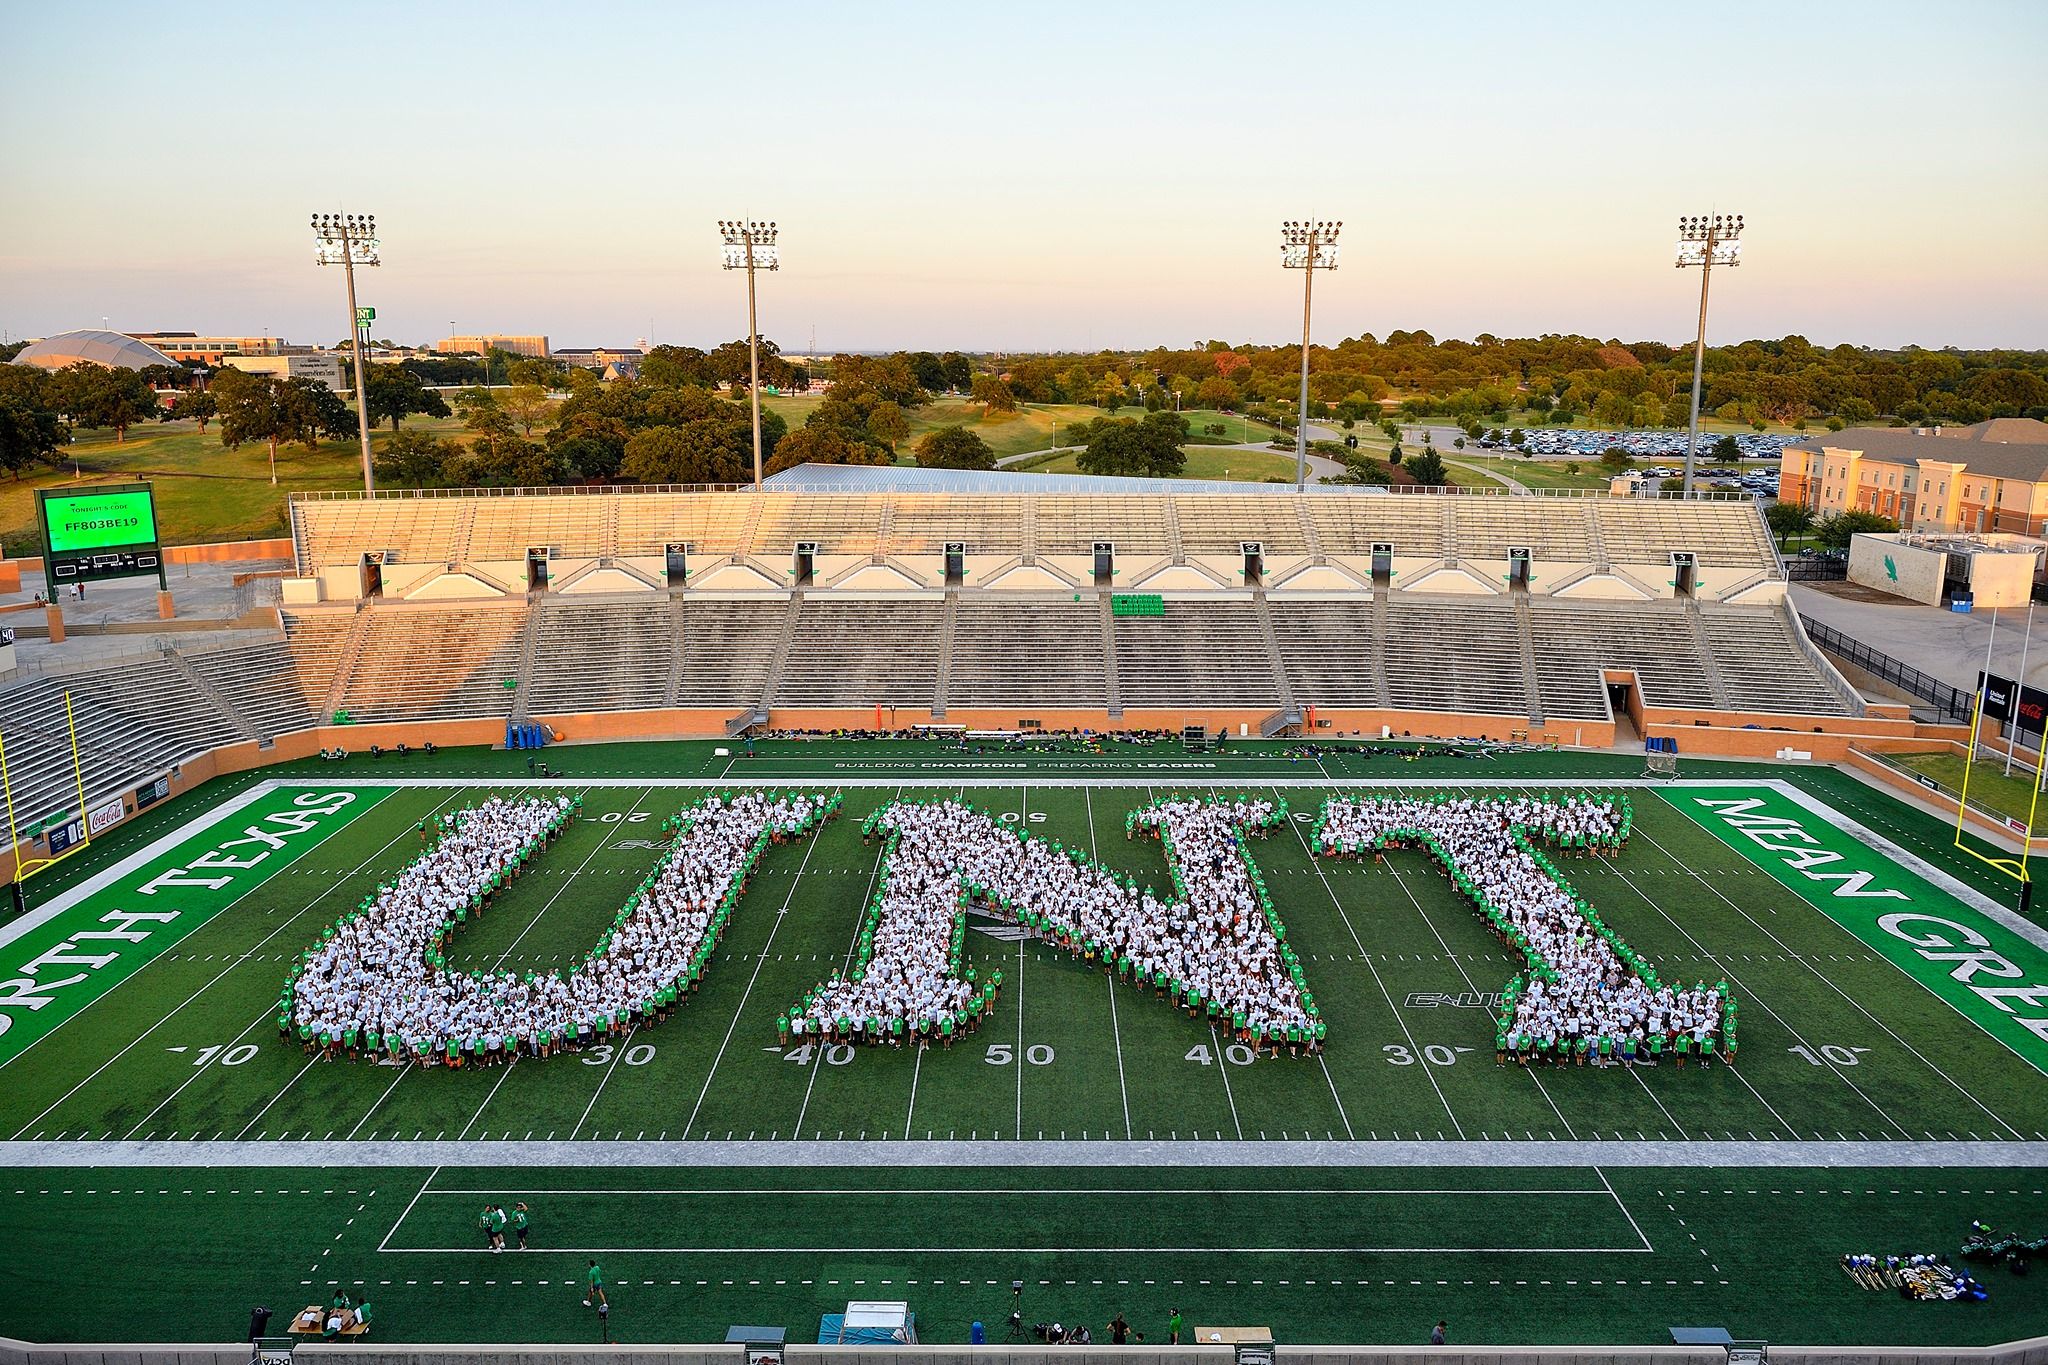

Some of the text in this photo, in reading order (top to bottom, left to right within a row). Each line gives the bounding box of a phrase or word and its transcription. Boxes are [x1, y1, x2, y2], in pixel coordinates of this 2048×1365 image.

[65, 517, 138, 532] FF803BE19
[92, 802, 121, 830] CocaCola
[601, 812, 652, 823] 20
[1001, 812, 1048, 823] 50
[136, 791, 358, 896] TEXAS
[1692, 797, 1914, 902] MEAN
[191, 1044, 260, 1066] 10
[581, 1044, 657, 1066] 30
[783, 1043, 856, 1066] 40
[984, 1044, 1056, 1065] 50
[1184, 1044, 1255, 1066] 40
[1382, 1044, 1457, 1066] 30
[1787, 1044, 1860, 1066] 10
